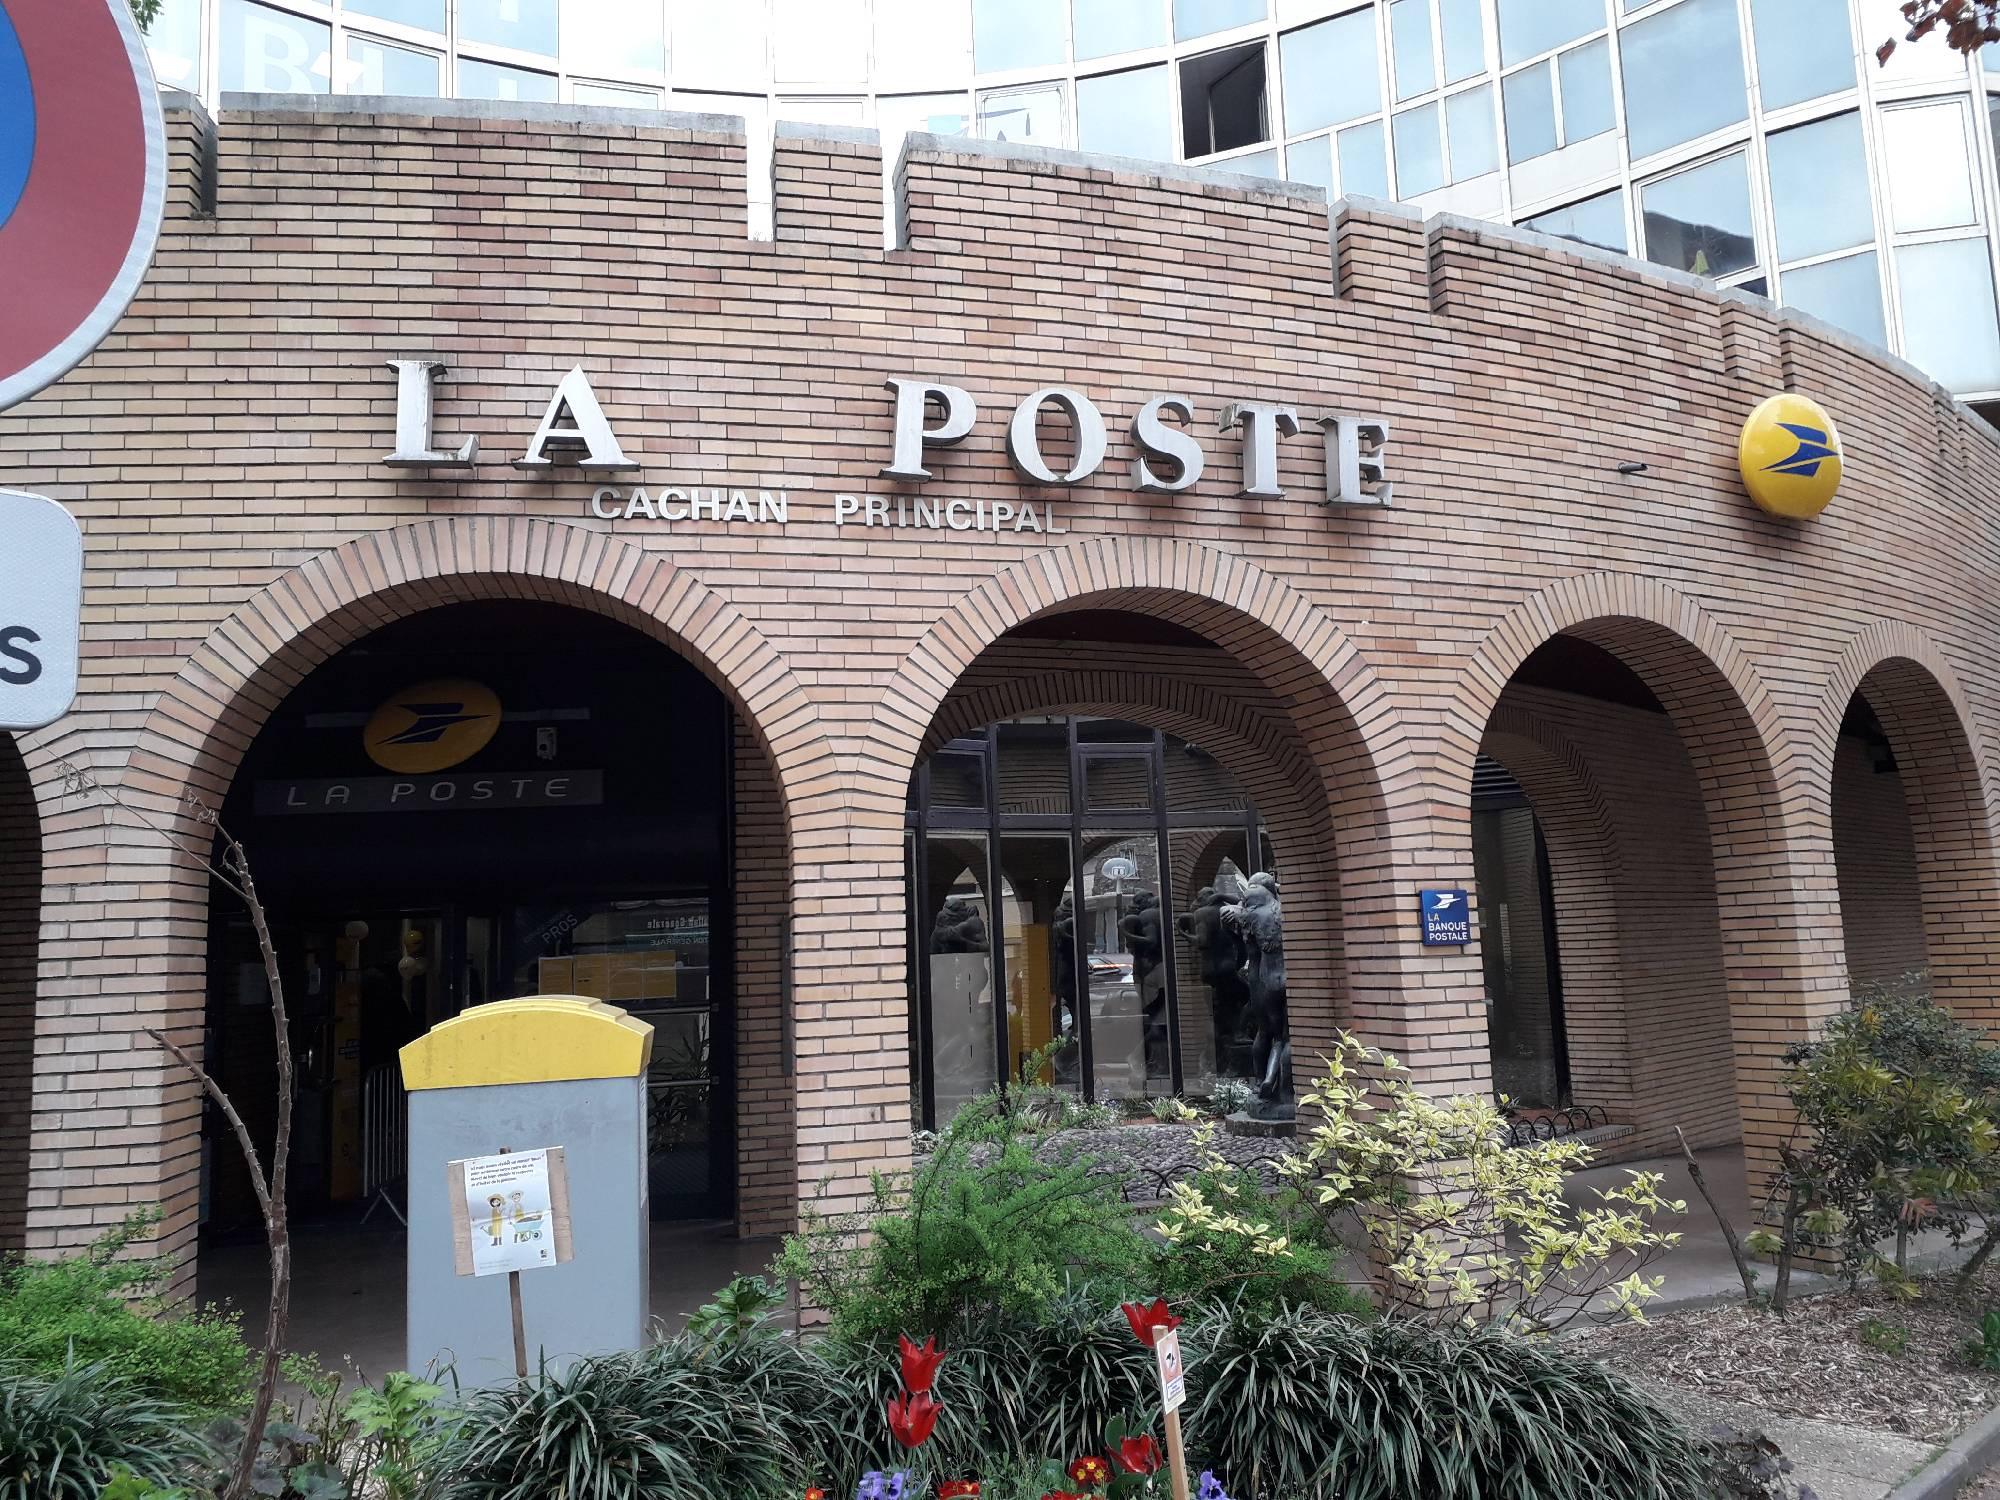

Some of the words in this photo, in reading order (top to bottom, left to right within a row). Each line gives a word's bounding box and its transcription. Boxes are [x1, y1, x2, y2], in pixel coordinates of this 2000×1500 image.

[383, 360, 640, 472] LA
[878, 377, 1393, 508] POSTE
[592, 487, 787, 523] CACHAN
[835, 494, 1067, 534] PRINCIPAL
[287, 785, 350, 806] LA
[390, 778, 570, 803] POSTE
[541, 913, 578, 944] PROS
[1427, 912, 1440, 921] LA
[1428, 921, 1468, 931] BANQUE
[1429, 932, 1468, 941] POSTALE
